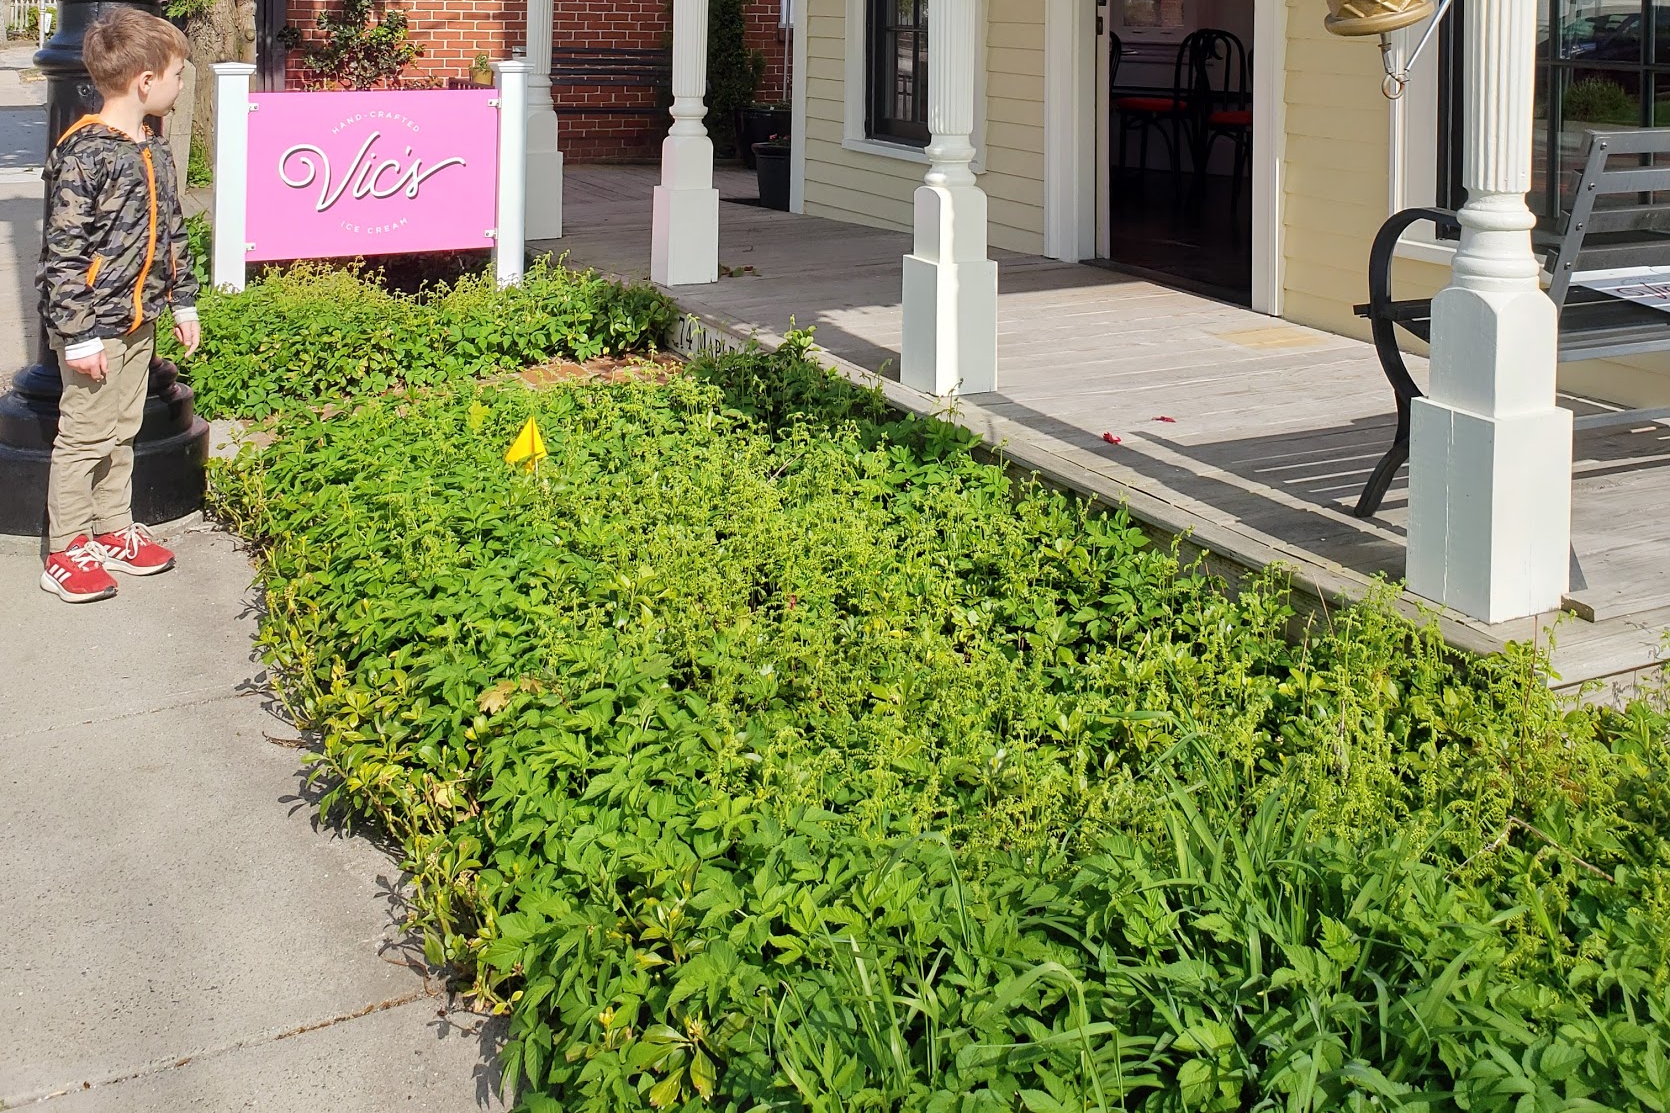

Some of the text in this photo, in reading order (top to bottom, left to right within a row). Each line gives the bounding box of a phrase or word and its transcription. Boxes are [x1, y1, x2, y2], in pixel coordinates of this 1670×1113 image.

[332, 110, 420, 134] HAND-CRAFTED
[278, 130, 466, 212] Vic's
[341, 217, 409, 235] ICE CREAM
